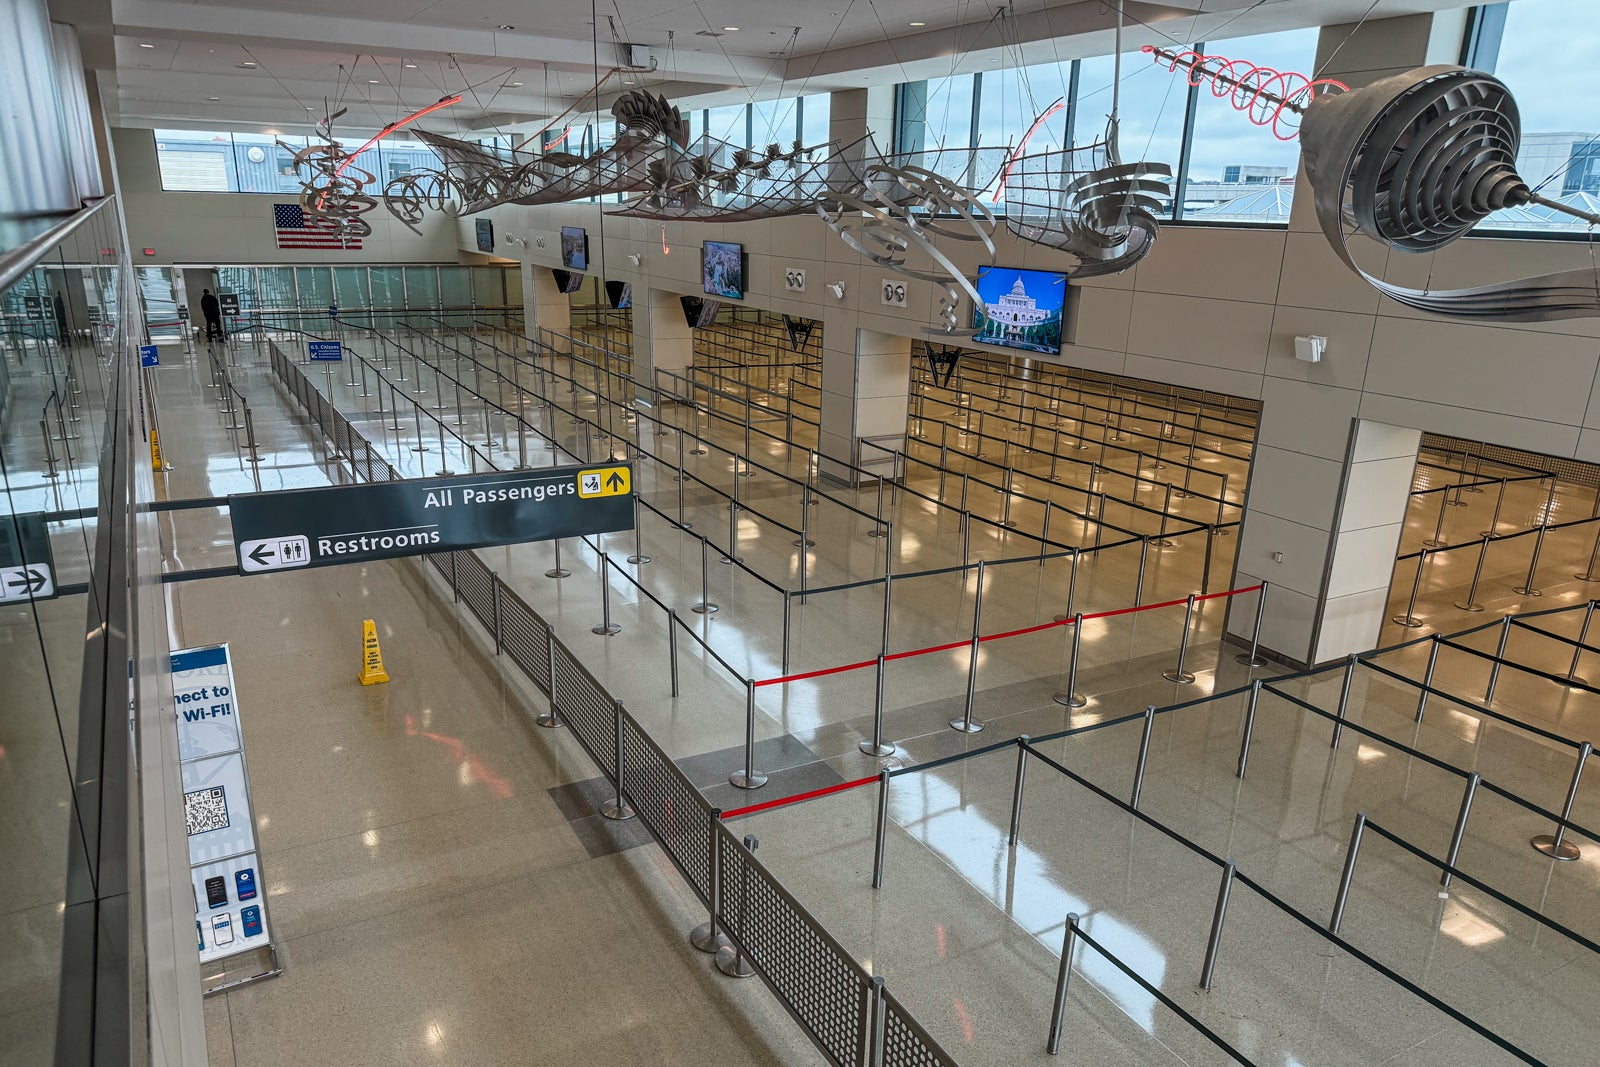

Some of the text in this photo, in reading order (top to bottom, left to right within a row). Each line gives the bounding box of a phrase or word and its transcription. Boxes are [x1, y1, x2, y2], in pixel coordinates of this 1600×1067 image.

[424, 482, 575, 508] All Passengers
[319, 531, 441, 555] Restrooms
[174, 686, 230, 704] nect to
[183, 703, 231, 722] Wi-Fi!
